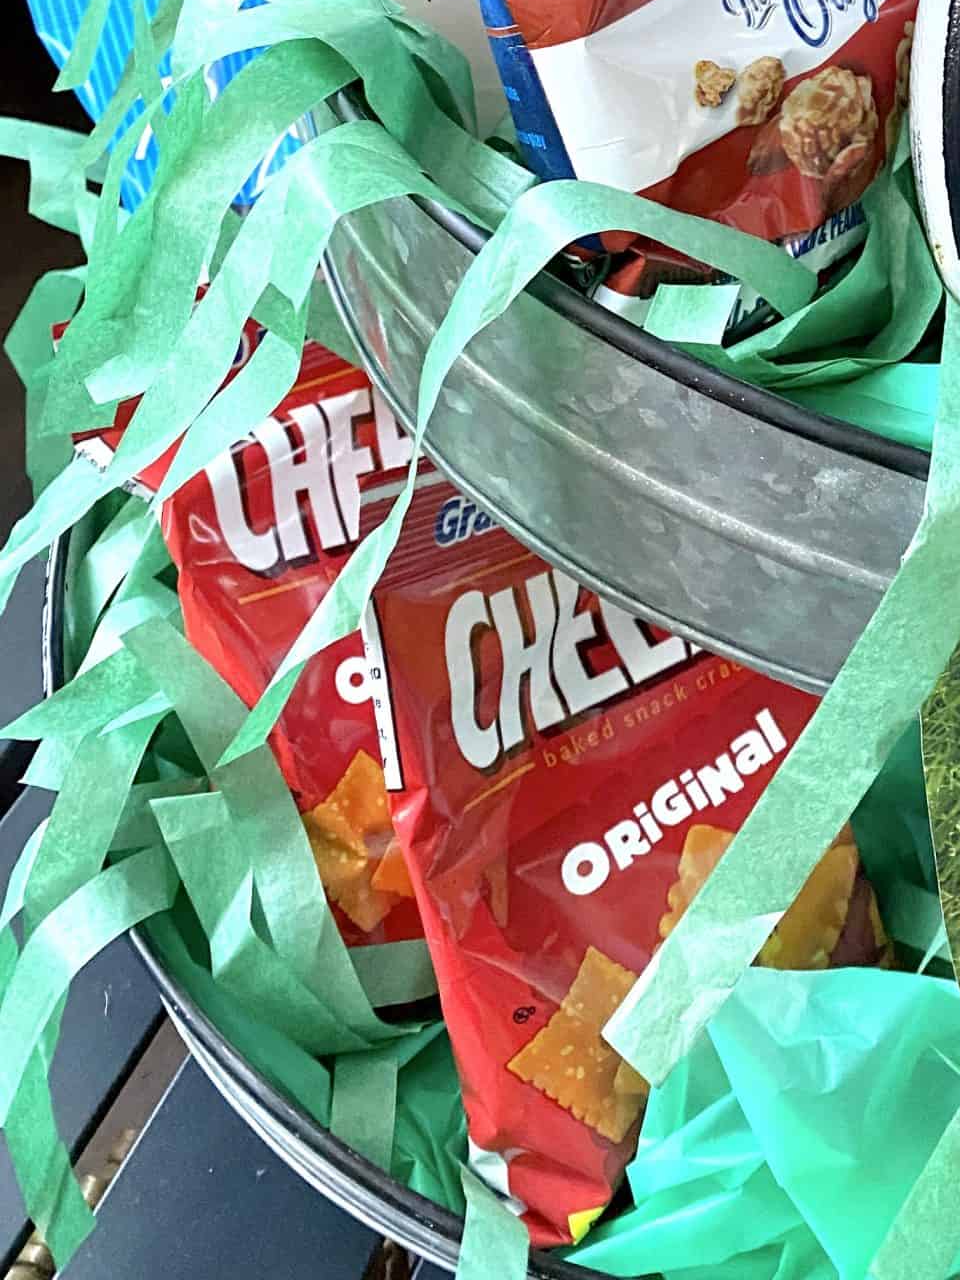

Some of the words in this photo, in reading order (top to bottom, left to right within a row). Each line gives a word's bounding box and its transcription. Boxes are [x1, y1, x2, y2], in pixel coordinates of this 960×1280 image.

[433, 497, 507, 548] Gra
[542, 717, 616, 769] baked
[622, 685, 688, 727] snack
